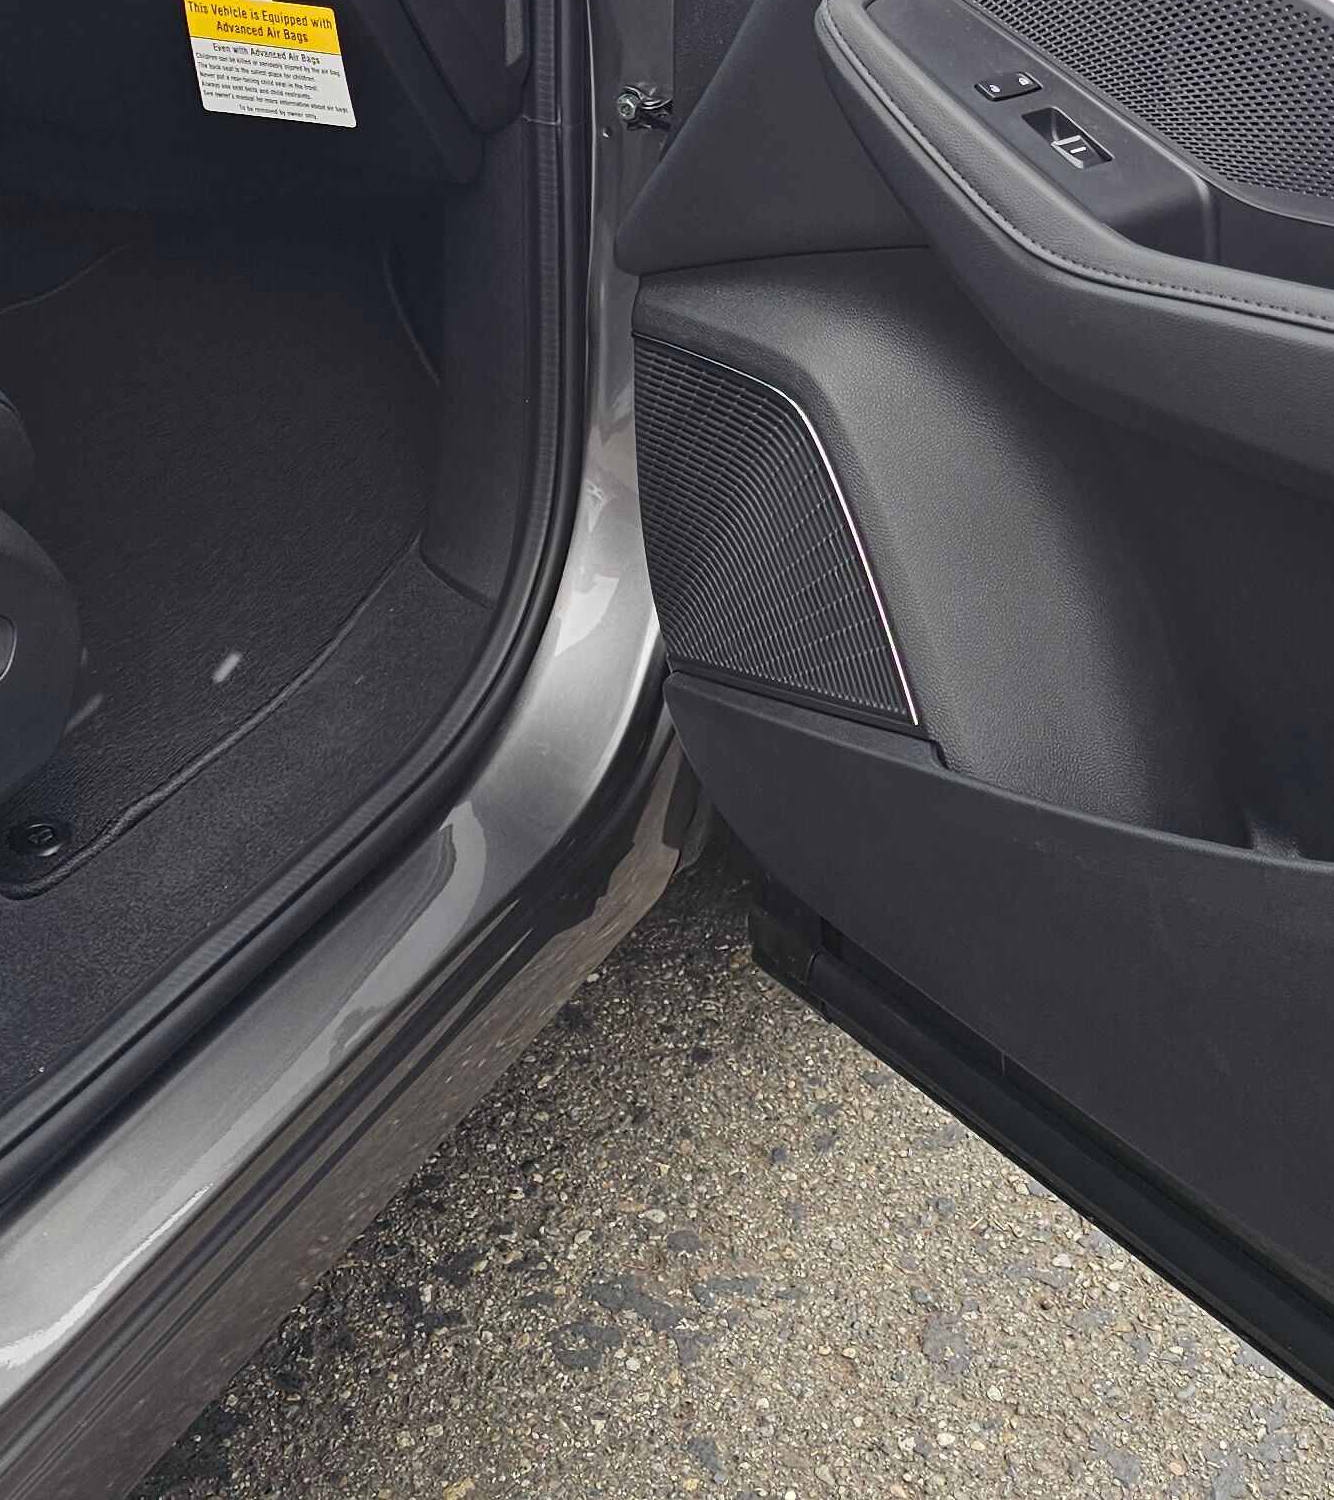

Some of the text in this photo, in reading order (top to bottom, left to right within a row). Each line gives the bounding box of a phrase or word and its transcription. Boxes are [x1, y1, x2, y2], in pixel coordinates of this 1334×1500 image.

[188, 1, 332, 29] This Vehicle is Equipped with
[217, 21, 308, 44] Advanced Air Bags
[213, 43, 320, 65] Even with Advanced Air Bags
